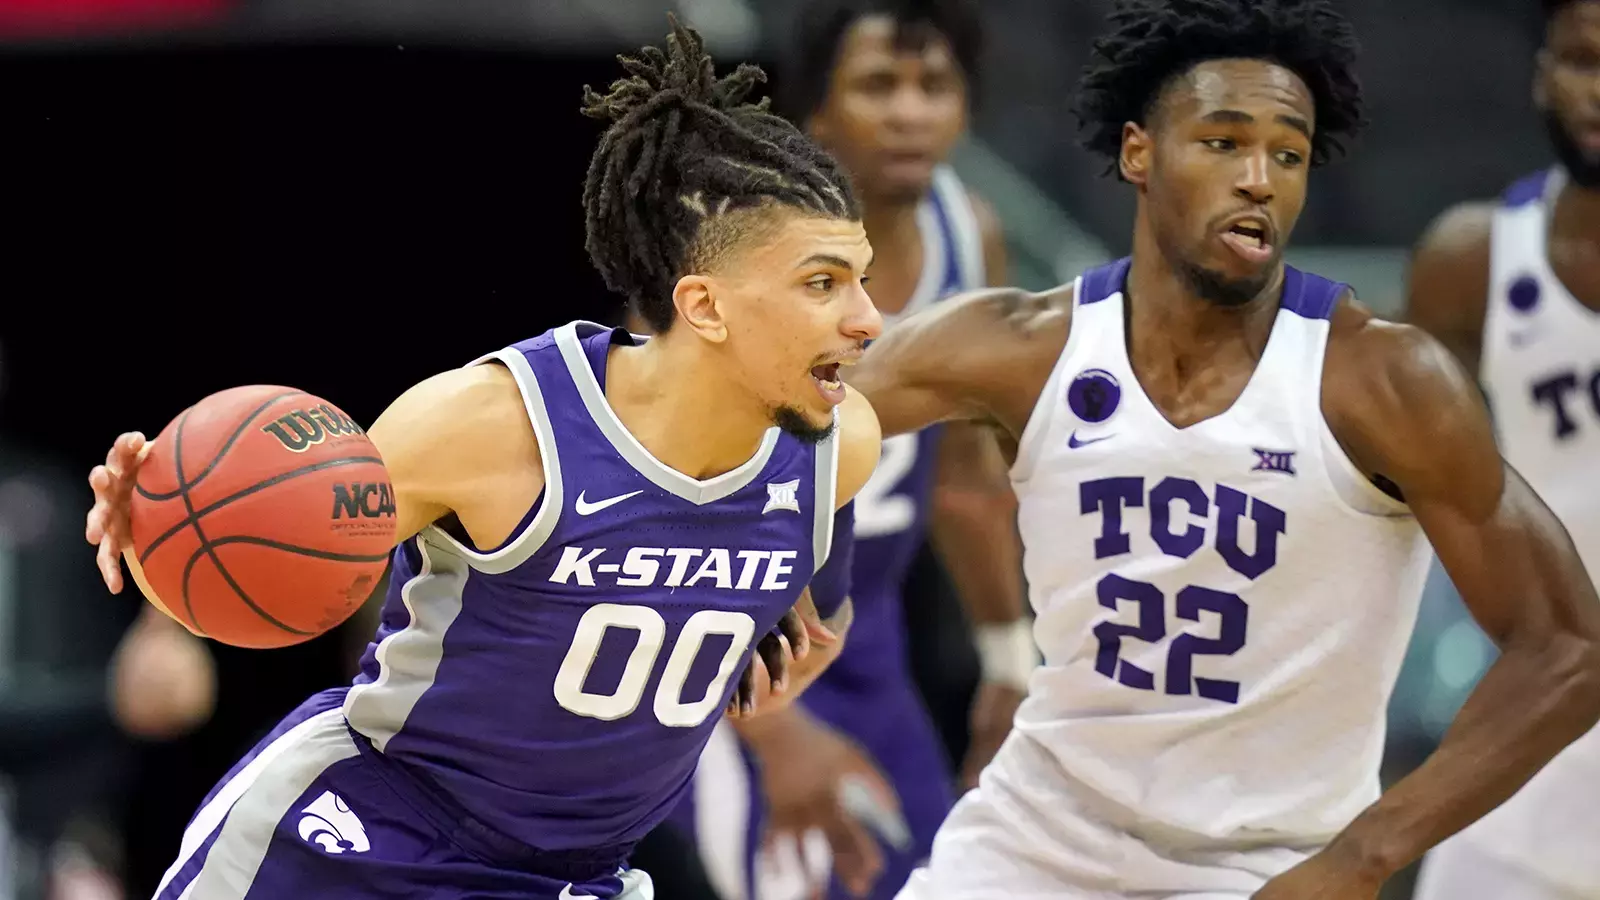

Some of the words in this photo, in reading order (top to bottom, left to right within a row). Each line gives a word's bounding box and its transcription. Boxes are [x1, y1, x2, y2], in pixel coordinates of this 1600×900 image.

[549, 546, 797, 591] K-STATE
[1079, 476, 1287, 581] TCU
[553, 603, 756, 728] 00
[1092, 573, 1249, 704] 22
